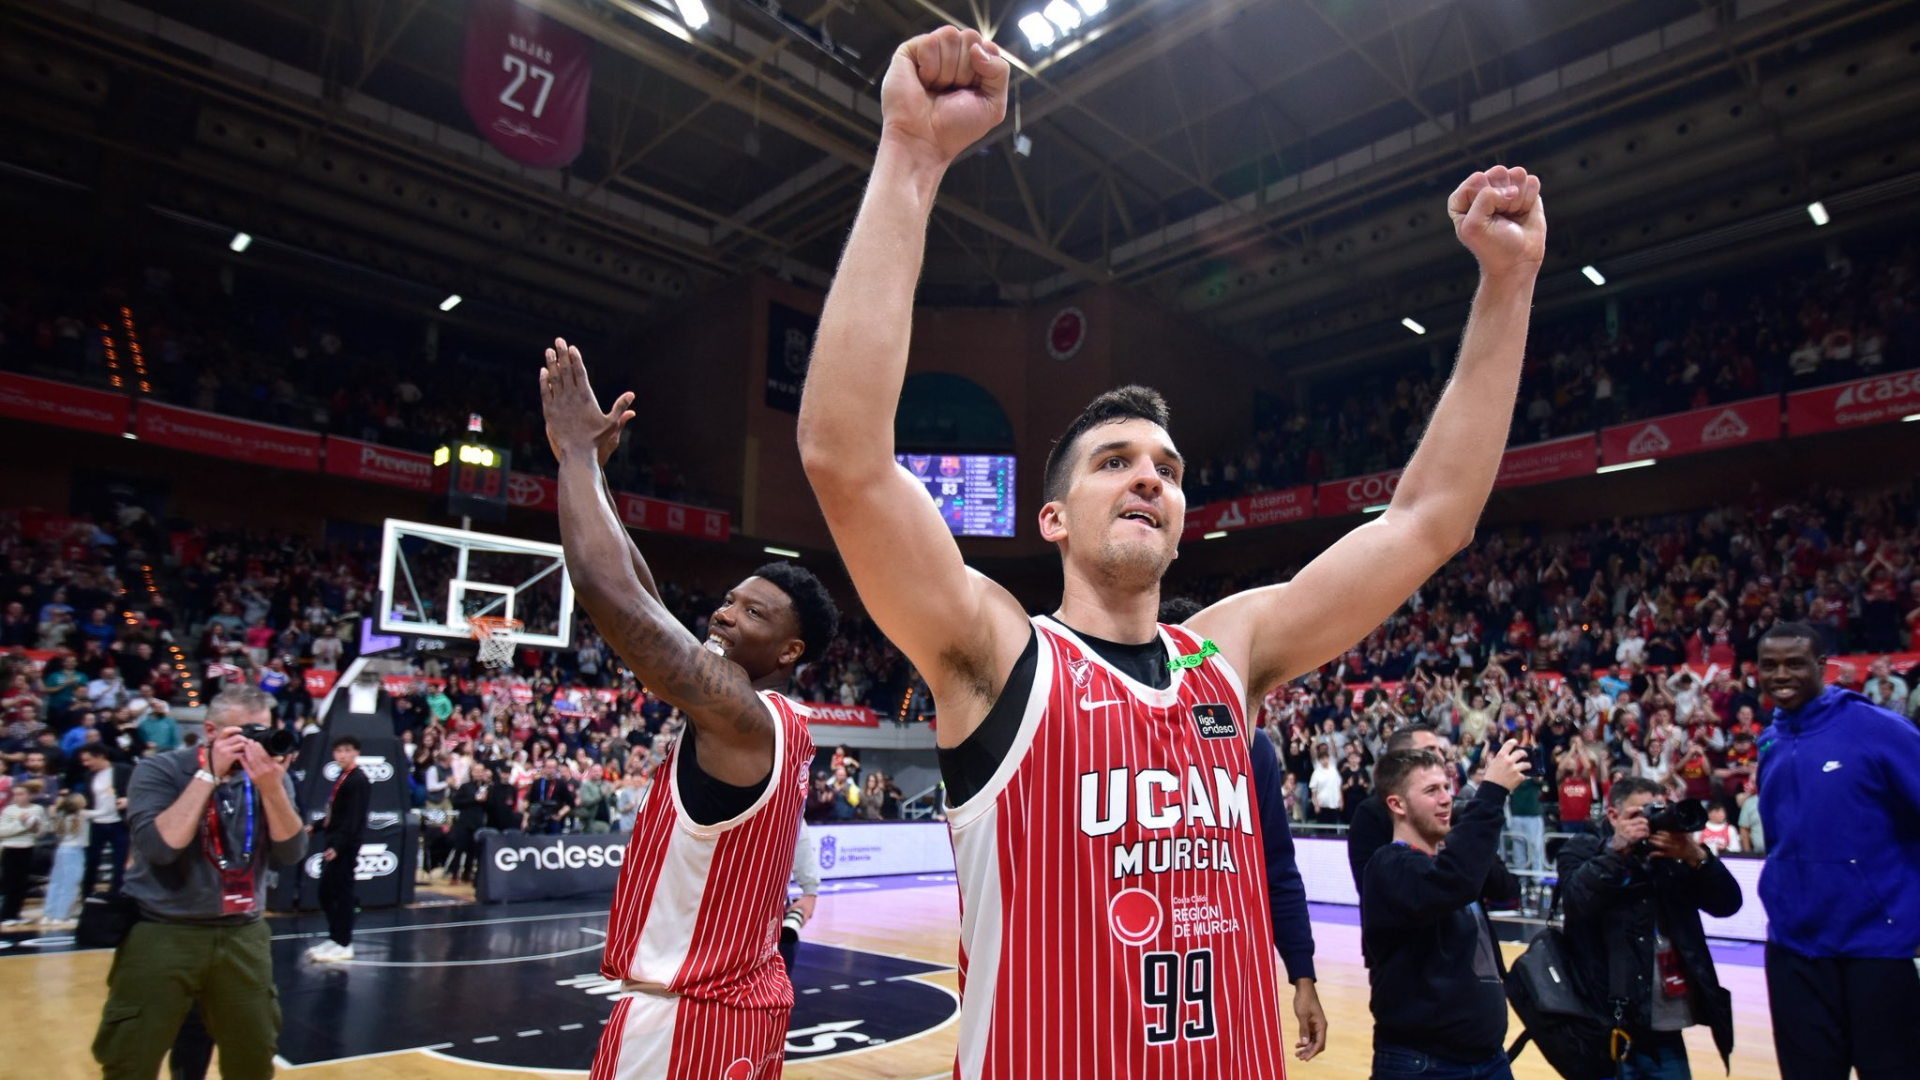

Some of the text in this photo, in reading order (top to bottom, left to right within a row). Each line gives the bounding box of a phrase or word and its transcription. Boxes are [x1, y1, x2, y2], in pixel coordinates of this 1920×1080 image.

[500, 53, 555, 119] 27
[941, 483, 958, 496] 83
[1249, 492, 1296, 510] Asterra
[1249, 505, 1303, 524] Partners
[1198, 714, 1216, 726] liga
[1202, 723, 1235, 735] endesa
[1079, 764, 1255, 838] UCAM
[494, 839, 626, 872] endesa
[1113, 837, 1238, 880] MURCIA
[1173, 896, 1190, 904] Costa
[1173, 903, 1219, 922] REGIÓN
[1173, 918, 1241, 938] DE MURCIA
[1141, 948, 1218, 1046] 99
